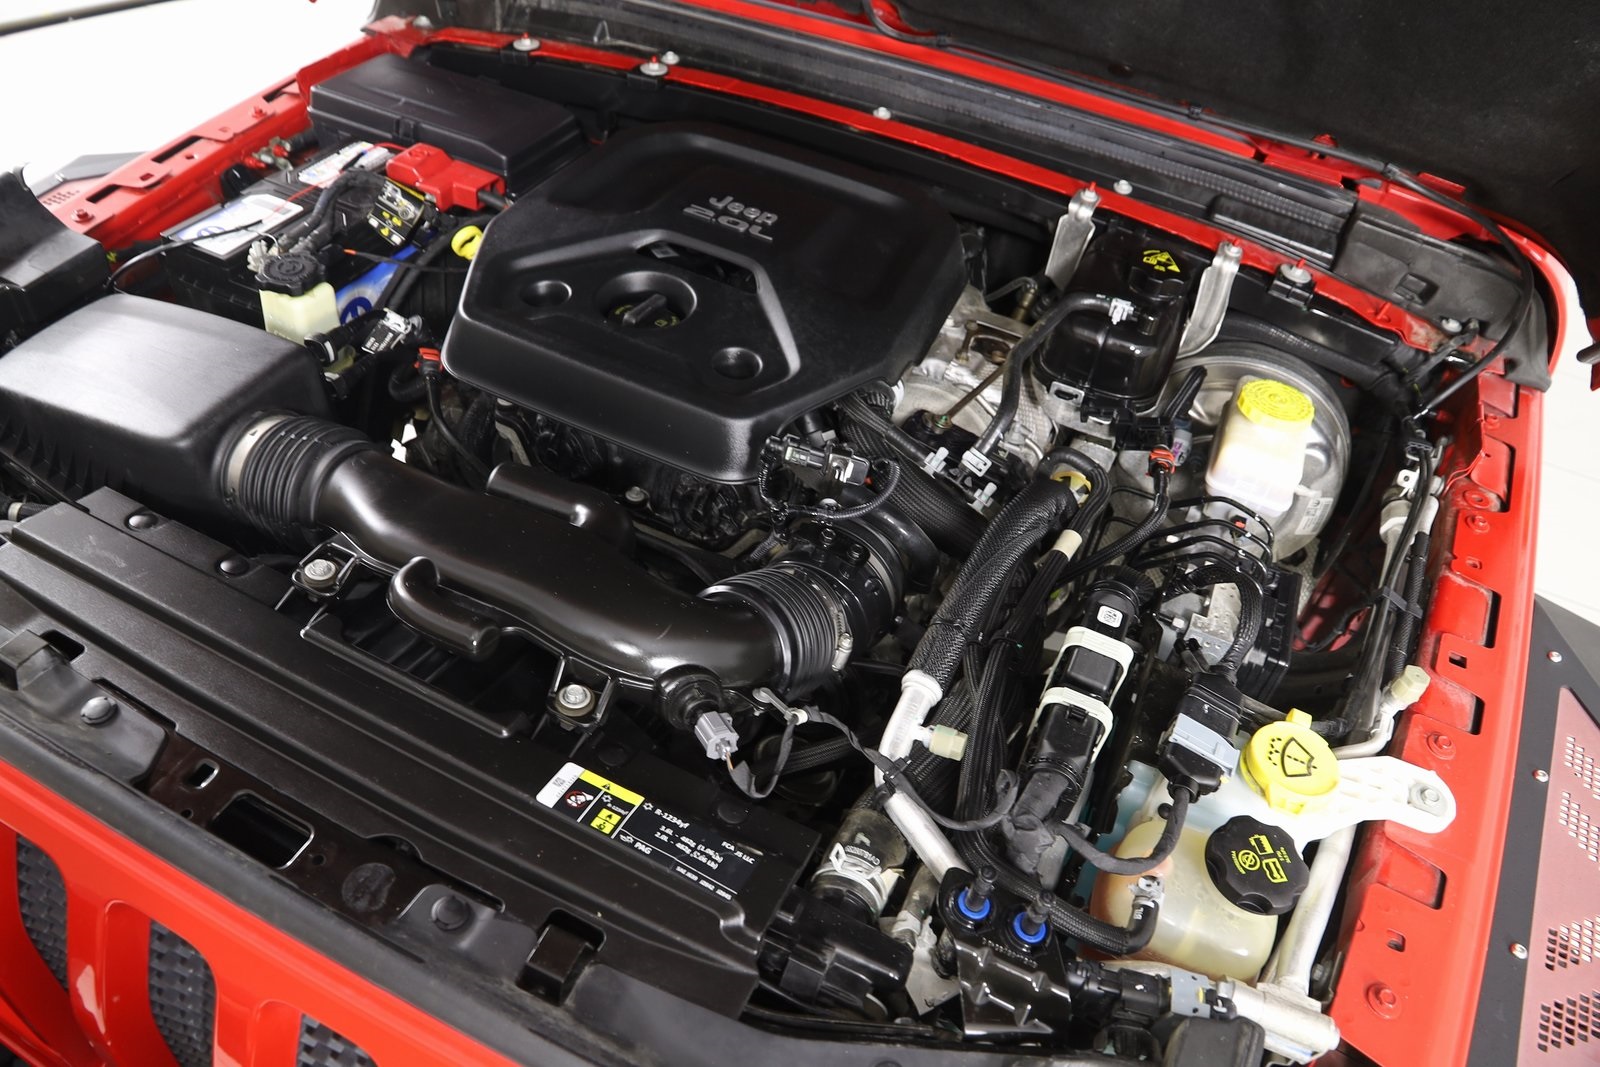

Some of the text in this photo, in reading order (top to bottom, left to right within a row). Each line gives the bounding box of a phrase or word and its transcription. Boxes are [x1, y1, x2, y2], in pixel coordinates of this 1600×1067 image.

[683, 204, 773, 241] 2.0L
[709, 196, 778, 226] Jeep
[654, 808, 690, 829] R-1234yf
[634, 842, 652, 855] PAG
[721, 841, 735, 851] FCA
[741, 854, 755, 864] LLC
